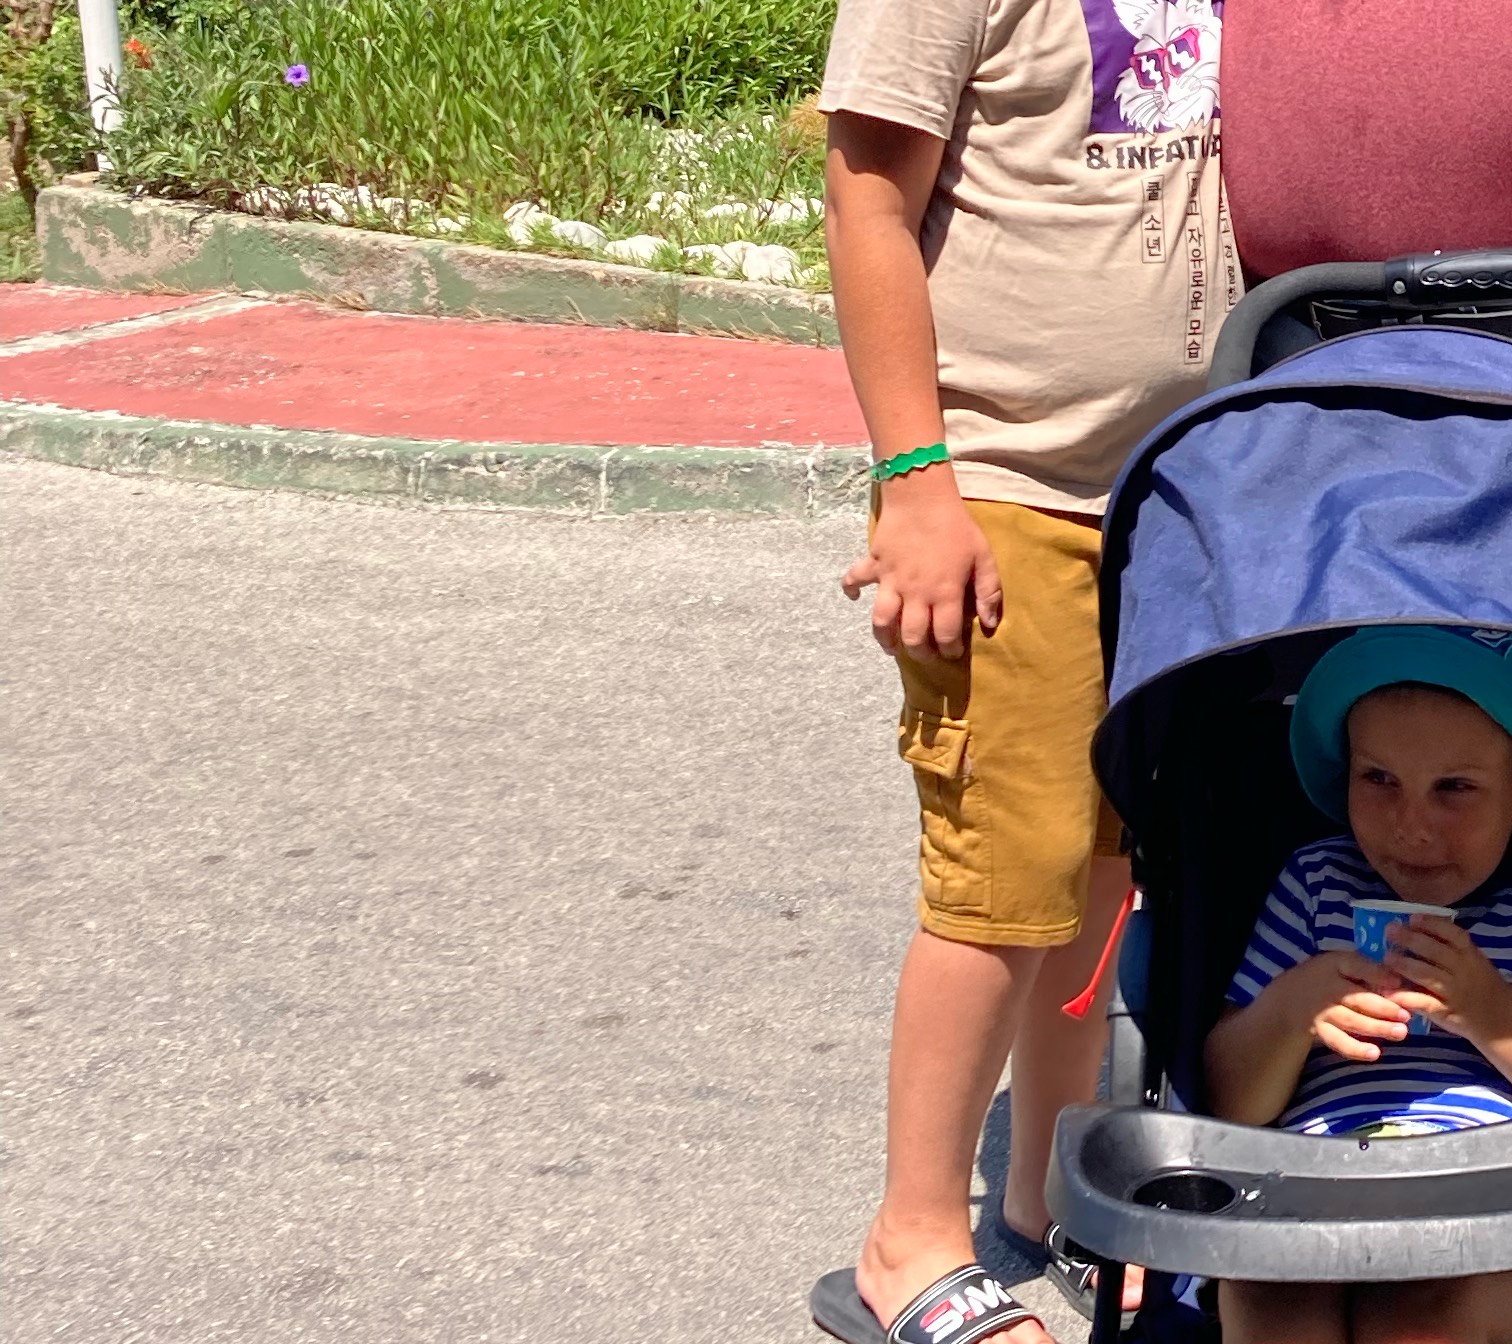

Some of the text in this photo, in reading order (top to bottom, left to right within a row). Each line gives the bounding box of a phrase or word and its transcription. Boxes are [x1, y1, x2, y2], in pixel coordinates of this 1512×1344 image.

[1086, 142, 1111, 169] &
[1144, 181, 1162, 257] 쿨 소년
[1186, 319, 1202, 359] 모습
